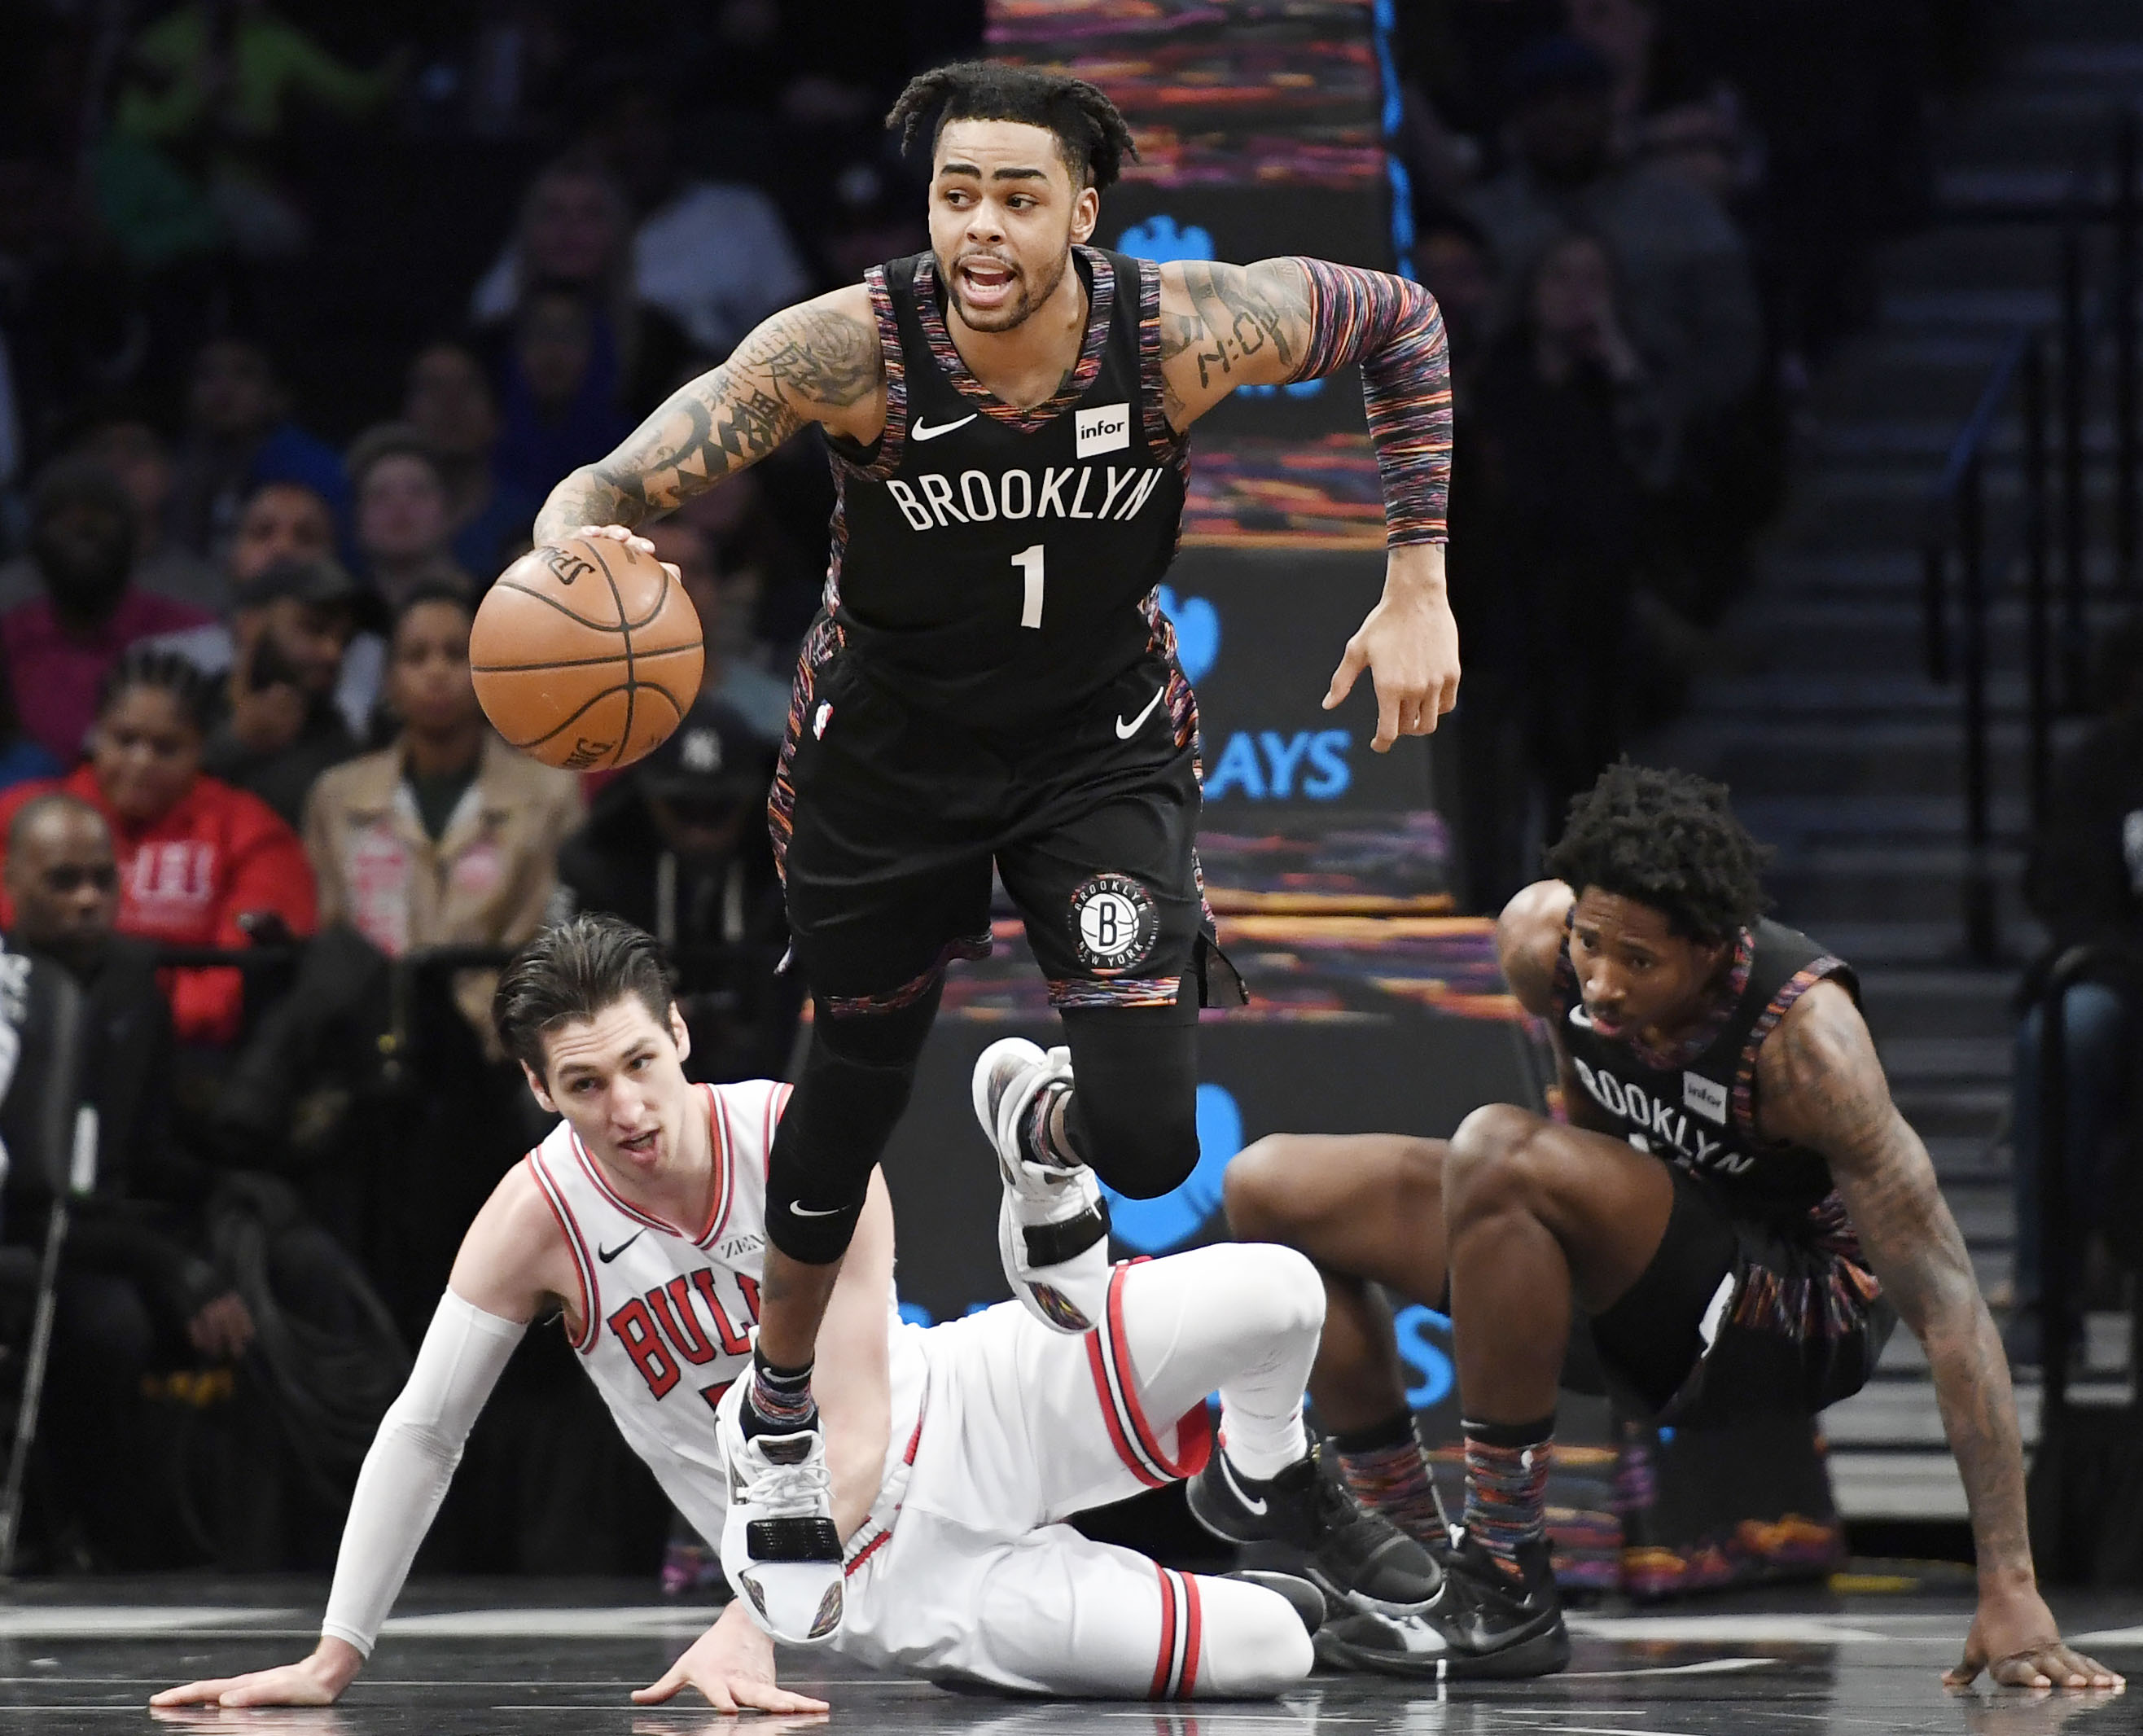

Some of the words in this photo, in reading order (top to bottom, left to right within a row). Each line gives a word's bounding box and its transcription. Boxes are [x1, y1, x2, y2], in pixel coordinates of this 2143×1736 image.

[1080, 420, 1126, 441] infor
[886, 467, 1164, 531] BROOKLYN
[1011, 544, 1045, 629] 1
[1203, 730, 1352, 800] AYS
[1074, 879, 1148, 912] BROOKLYN
[1098, 901, 1118, 947] B
[1078, 940, 1100, 966] NEW
[1107, 940, 1144, 967] YORK
